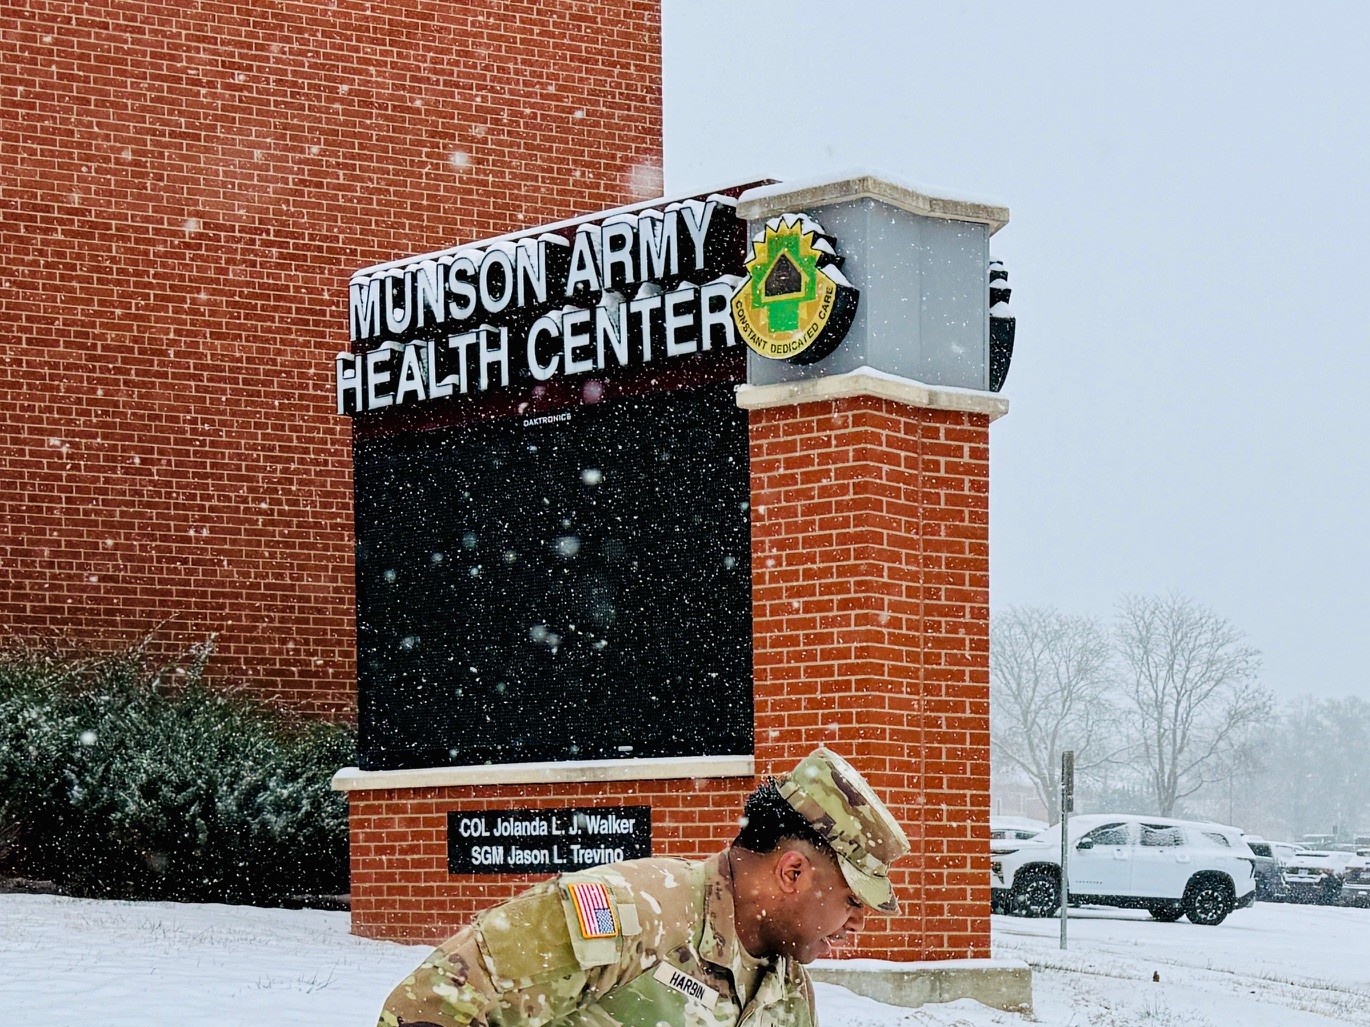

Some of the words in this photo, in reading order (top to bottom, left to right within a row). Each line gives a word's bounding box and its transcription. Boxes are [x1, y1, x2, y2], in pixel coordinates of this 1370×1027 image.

[349, 240, 547, 342] MUNSON
[565, 200, 717, 297] ARMY
[735, 300, 768, 350] CONSTANT
[770, 322, 819, 354] DEDICATED
[818, 286, 834, 320] CARE
[335, 326, 510, 415] HEALTH
[526, 282, 737, 382] CENTER
[460, 818, 490, 837] COL
[493, 817, 548, 837] Jolanda
[551, 816, 565, 835] L.
[569, 815, 582, 836] J.
[585, 814, 636, 835] Walker
[471, 845, 504, 865] SGM
[507, 845, 549, 865] Jason
[553, 845, 567, 864] L.
[570, 844, 624, 864] Trevino
[669, 971, 706, 1000] HARBIN
